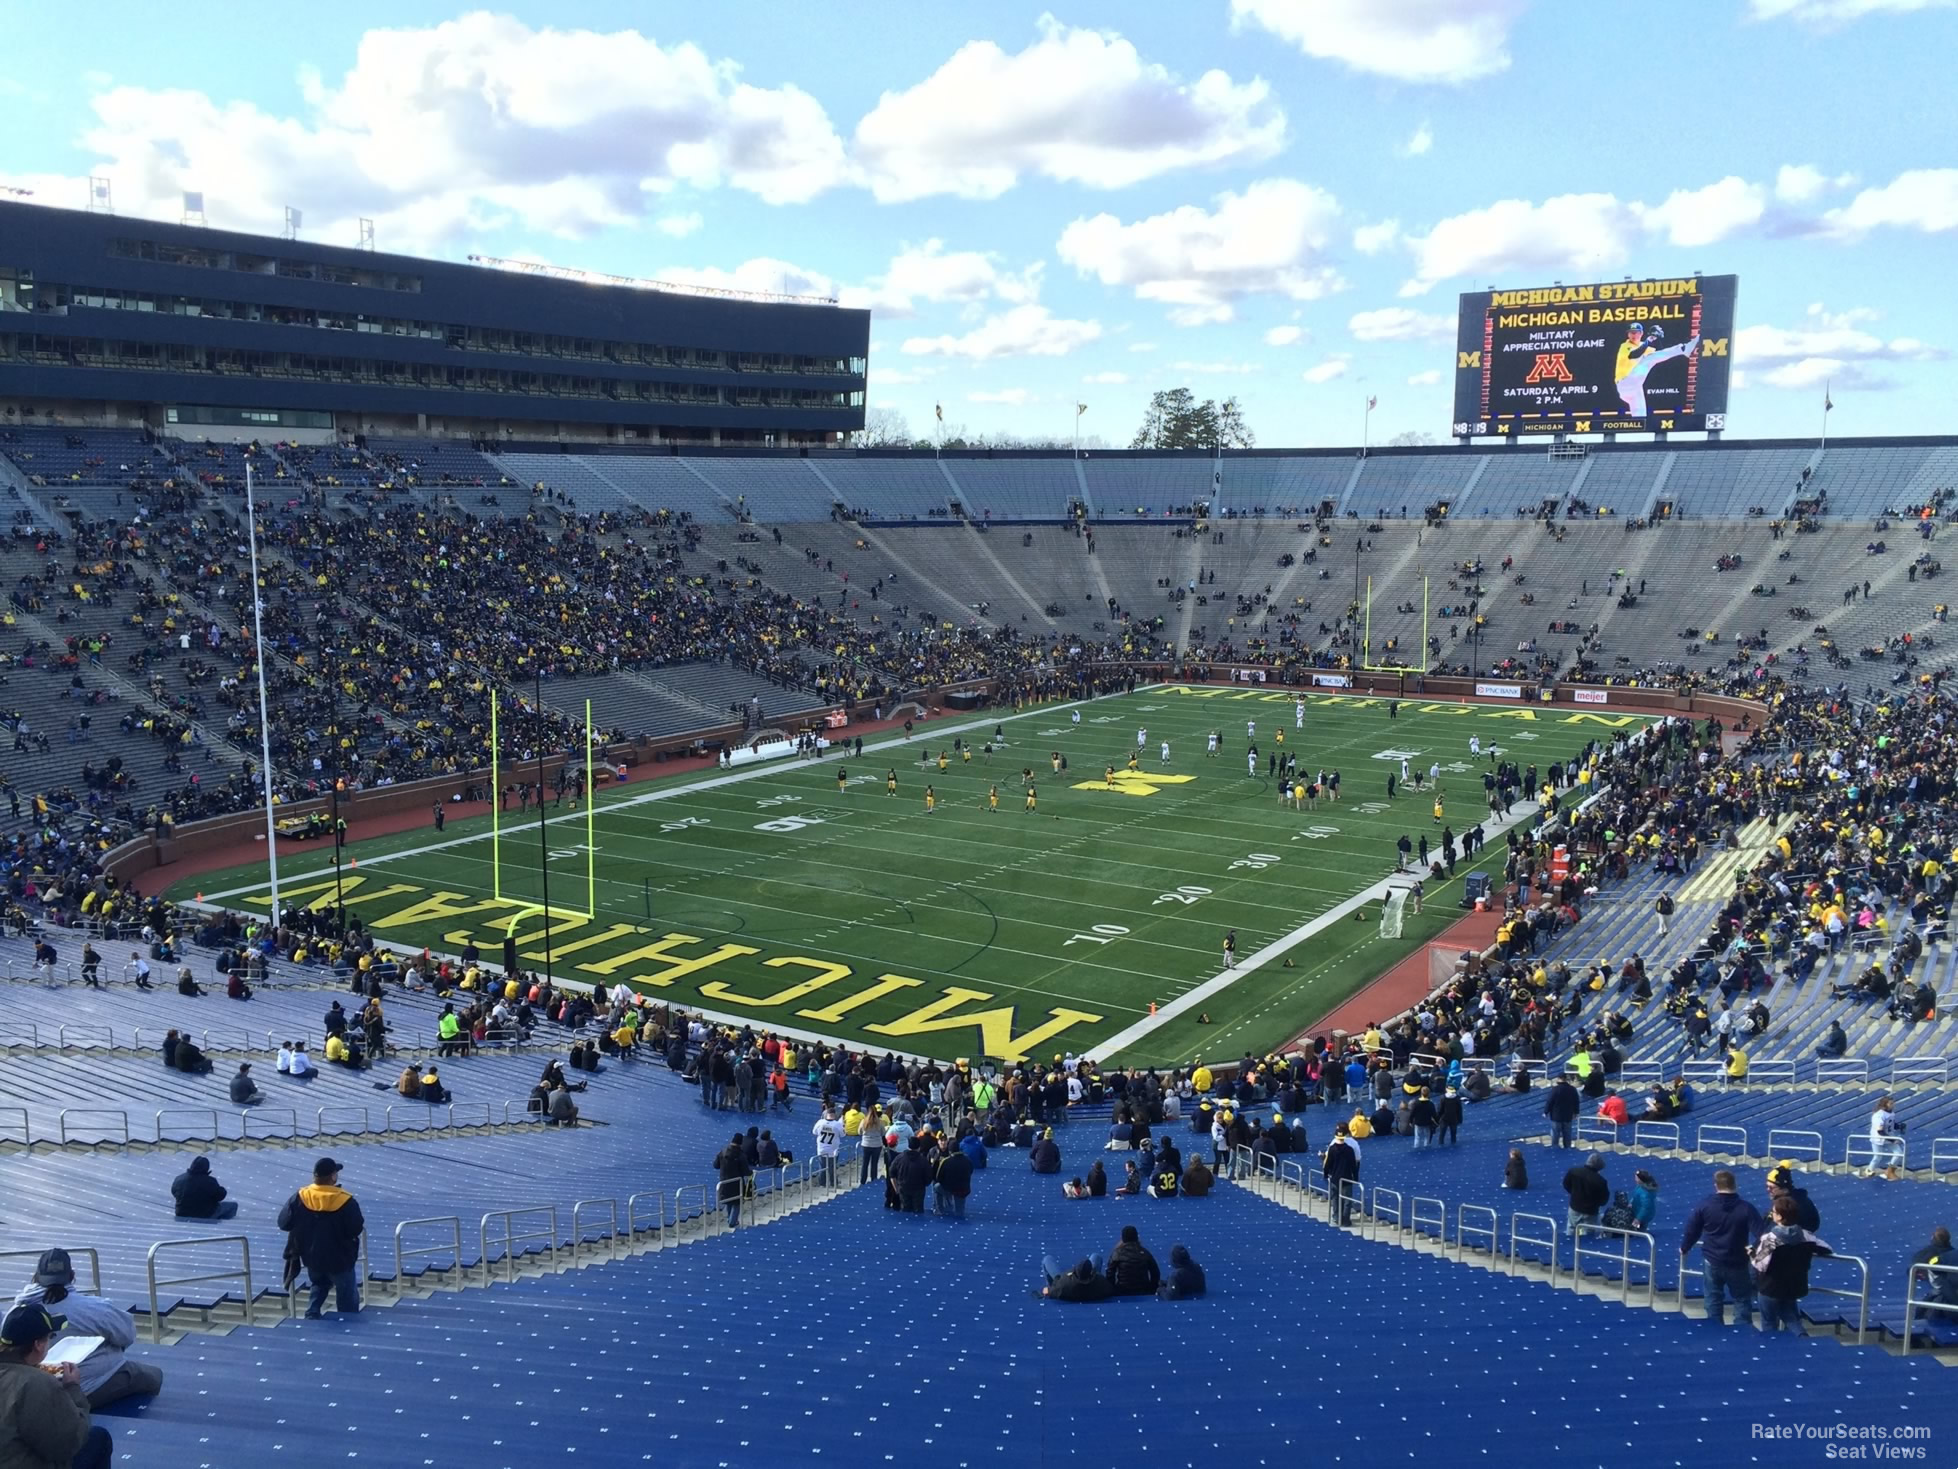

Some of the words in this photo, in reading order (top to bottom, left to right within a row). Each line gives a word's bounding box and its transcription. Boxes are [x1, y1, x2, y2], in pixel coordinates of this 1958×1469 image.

[1491, 286, 1594, 306] MICHIGAN
[1599, 279, 1697, 300] STADIUM
[1500, 310, 1584, 328] MICHIGAN
[1588, 304, 1685, 323] BASEBALL
[1529, 330, 1575, 340] MILITARY
[1502, 341, 1574, 352] APPRECIATION
[1576, 339, 1605, 349] GAME
[1702, 338, 1728, 357] M
[1459, 351, 1481, 368] M
[1526, 353, 1573, 383] M
[1503, 386, 1558, 396] SATURDAY,
[1560, 385, 1589, 394] APRIL
[1591, 385, 1599, 393] 9
[1498, 424, 1509, 433] M
[1576, 421, 1591, 432] M
[1660, 420, 1674, 429] M
[1577, 692, 1604, 701] meijer
[1148, 685, 1645, 727] MICHIGAN
[660, 816, 711, 831] 20
[1299, 825, 1340, 839] 40
[1232, 853, 1282, 869] 30
[1159, 885, 1213, 904] 20
[1072, 924, 1130, 945] 10
[242, 875, 1104, 1062] MICHIGAN
[820, 1131, 835, 1144] 77
[1159, 1172, 1176, 1190] 32
